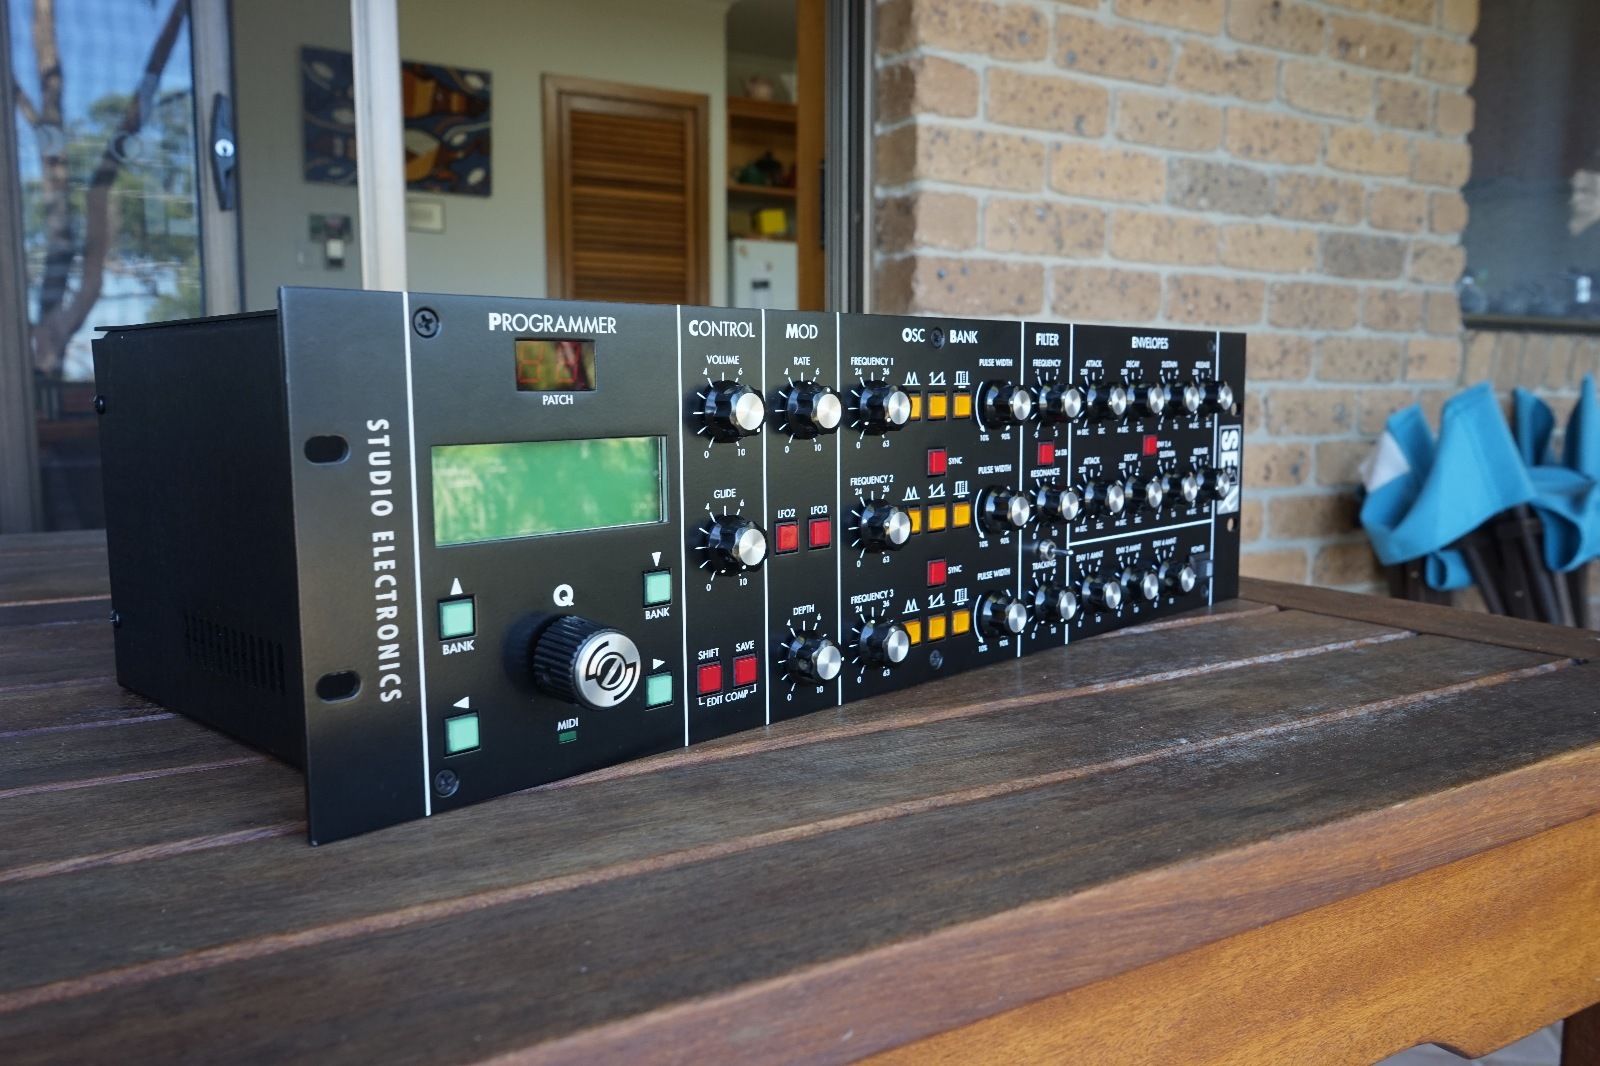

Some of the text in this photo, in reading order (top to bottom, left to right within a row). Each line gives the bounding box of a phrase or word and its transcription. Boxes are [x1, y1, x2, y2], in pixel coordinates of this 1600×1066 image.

[488, 312, 617, 334] PROGRAMMER
[688, 319, 756, 338] CONTROL
[785, 323, 819, 339] MOD
[901, 327, 979, 344] OSC BANK
[1035, 332, 1059, 346] FILTER
[1131, 336, 1169, 350] ENVELOPES
[706, 354, 740, 366] VOLUME
[793, 356, 811, 366] RATE
[850, 356, 894, 366] FREQUENCY 1
[978, 358, 1013, 367] PULSE WIDTH
[1032, 358, 1062, 368] FREQUENCY
[1084, 359, 1103, 368] ATTACK
[702, 367, 708, 376] 4
[738, 367, 744, 376] 6
[783, 367, 789, 376] 4
[815, 367, 820, 376] 6
[854, 367, 863, 376] 24
[882, 367, 890, 376] 36
[542, 394, 574, 406] PATCH
[814, 443, 822, 452] 10
[882, 440, 890, 448] 63
[737, 448, 746, 457] 10
[784, 445, 790, 454] 0
[703, 450, 710, 459] 0
[948, 456, 963, 465] SYNC
[1083, 456, 1101, 465] ATTACK
[977, 464, 1012, 475] PULSE WIDTH
[1030, 467, 1061, 478] RESONANCE
[850, 474, 894, 486] FREQUENCY 2
[713, 488, 737, 499] GLIDE
[854, 487, 863, 496] 24
[882, 485, 890, 493] 36
[704, 502, 710, 511] 4
[739, 499, 745, 507] 6
[777, 508, 796, 519] LFO2
[810, 505, 828, 515] LFO3
[366, 418, 403, 703] STUDIO ELECTRONICS
[856, 560, 862, 568] 0
[882, 556, 890, 564] 63
[1032, 559, 1057, 570] TRACKING
[947, 564, 963, 575] SYNC
[977, 567, 1011, 581] PULSE WIDTH
[739, 577, 748, 586] 10
[705, 583, 712, 592] 0
[553, 583, 574, 607] Q
[850, 588, 894, 605] FREQUENCY 3
[882, 600, 890, 608] 36
[645, 606, 670, 621] BANK
[793, 604, 815, 616] DEPTH
[855, 605, 863, 613] 24
[816, 613, 822, 621] 6
[786, 619, 792, 627] 4
[442, 639, 475, 656] BANK
[735, 640, 755, 652] SAVE
[698, 647, 720, 661] SHIFT
[882, 668, 891, 677] 63
[857, 675, 862, 684] 0
[816, 685, 824, 694] 10
[706, 689, 749, 707] EDIT COMP
[786, 693, 792, 702] 0
[557, 717, 579, 731] MIDI
